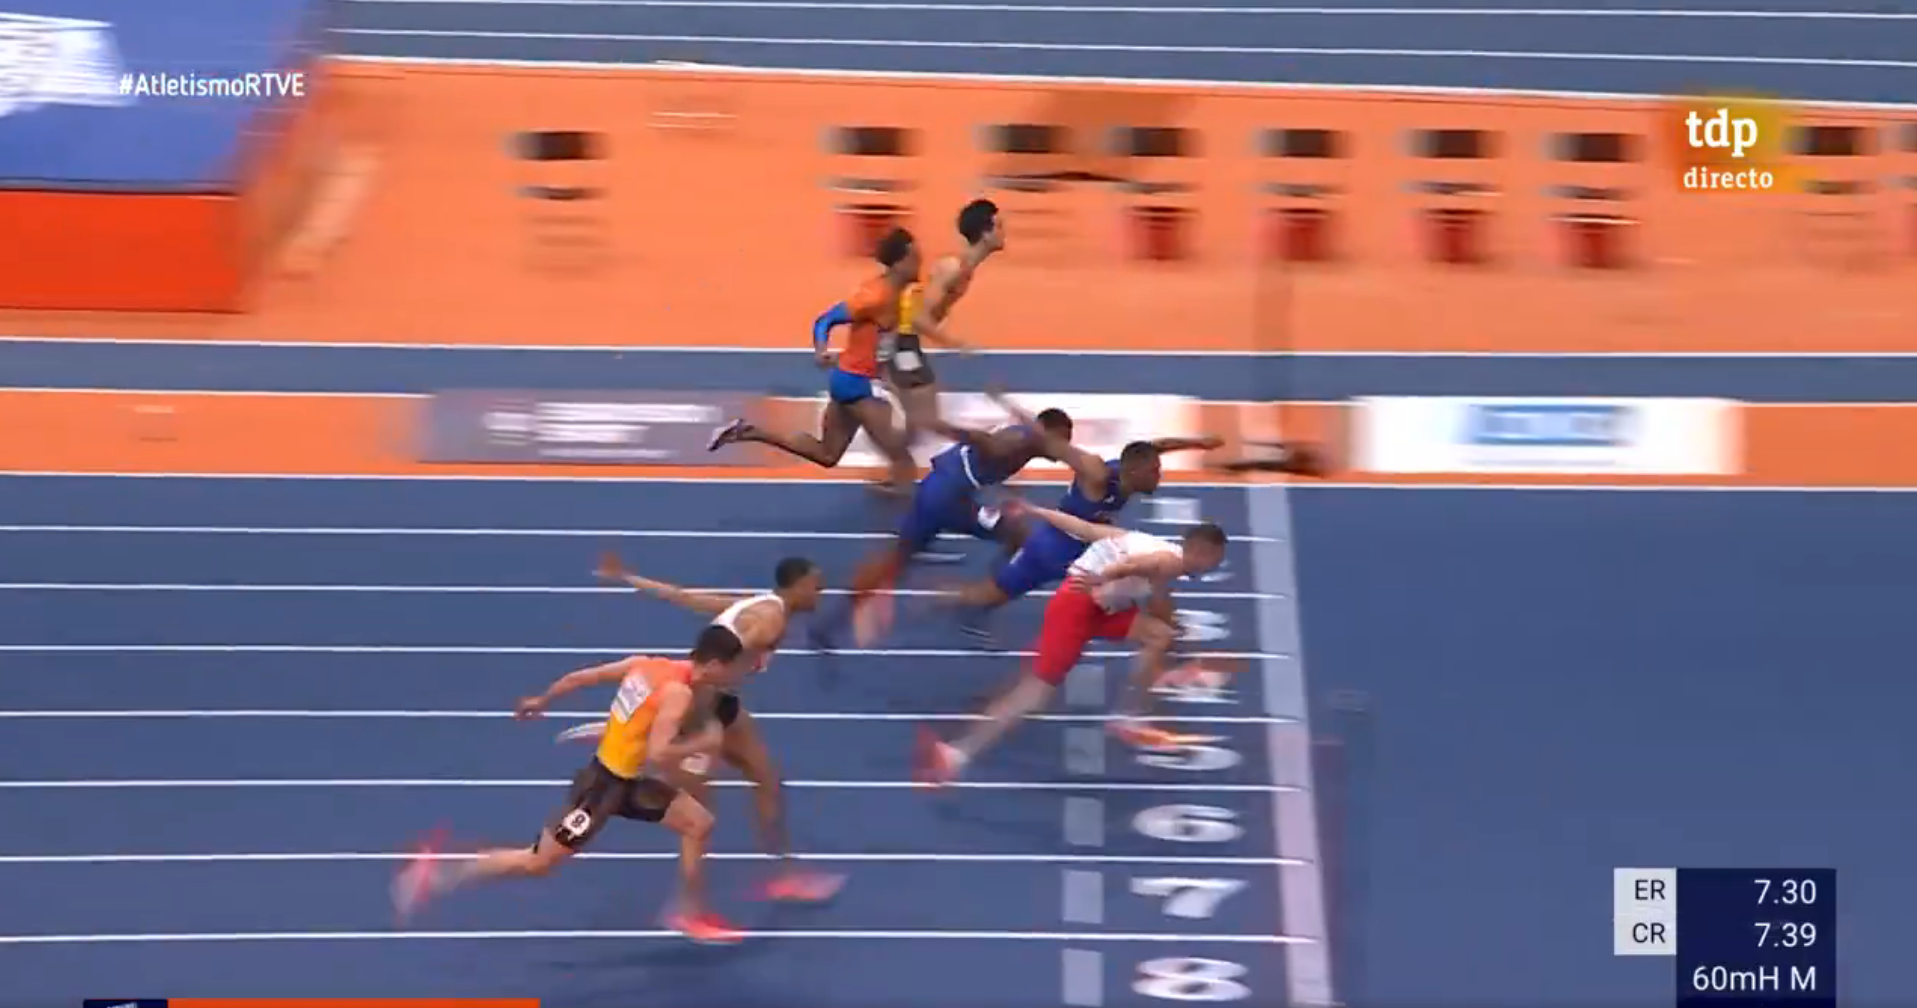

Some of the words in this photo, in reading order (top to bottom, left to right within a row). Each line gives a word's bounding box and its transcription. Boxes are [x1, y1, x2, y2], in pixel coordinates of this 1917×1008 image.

[1131, 804, 1246, 843] 6
[1129, 877, 1249, 919] 7
[1130, 956, 1252, 1001] 8
